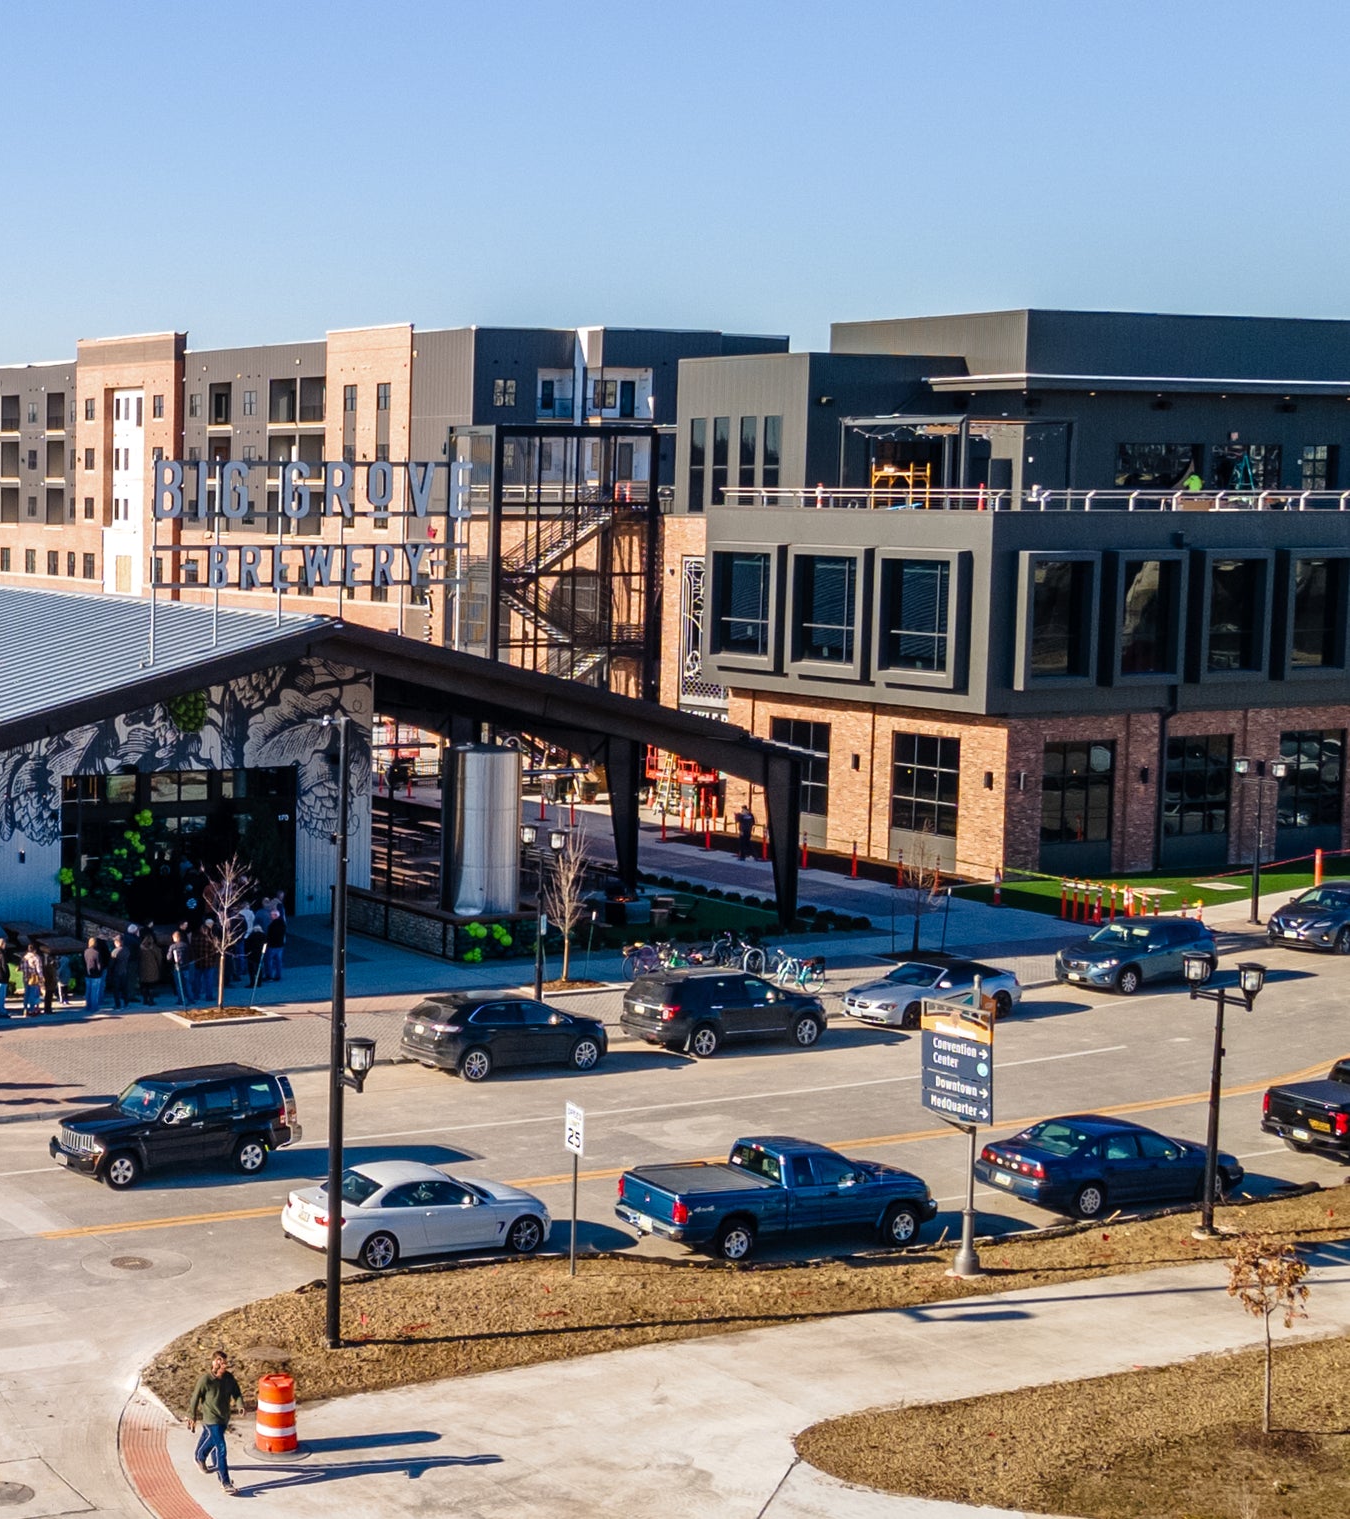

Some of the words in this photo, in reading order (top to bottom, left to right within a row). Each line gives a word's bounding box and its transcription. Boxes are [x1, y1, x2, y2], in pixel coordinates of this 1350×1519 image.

[155, 459, 250, 519] BIG
[283, 460, 474, 519] GROVE
[208, 544, 426, 589] BREWERY
[932, 1037, 977, 1059] Convention
[932, 1051, 959, 1068] Center
[935, 1075, 978, 1097] Downtown
[930, 1094, 978, 1117] MedQuarter
[567, 1127, 581, 1148] 25
